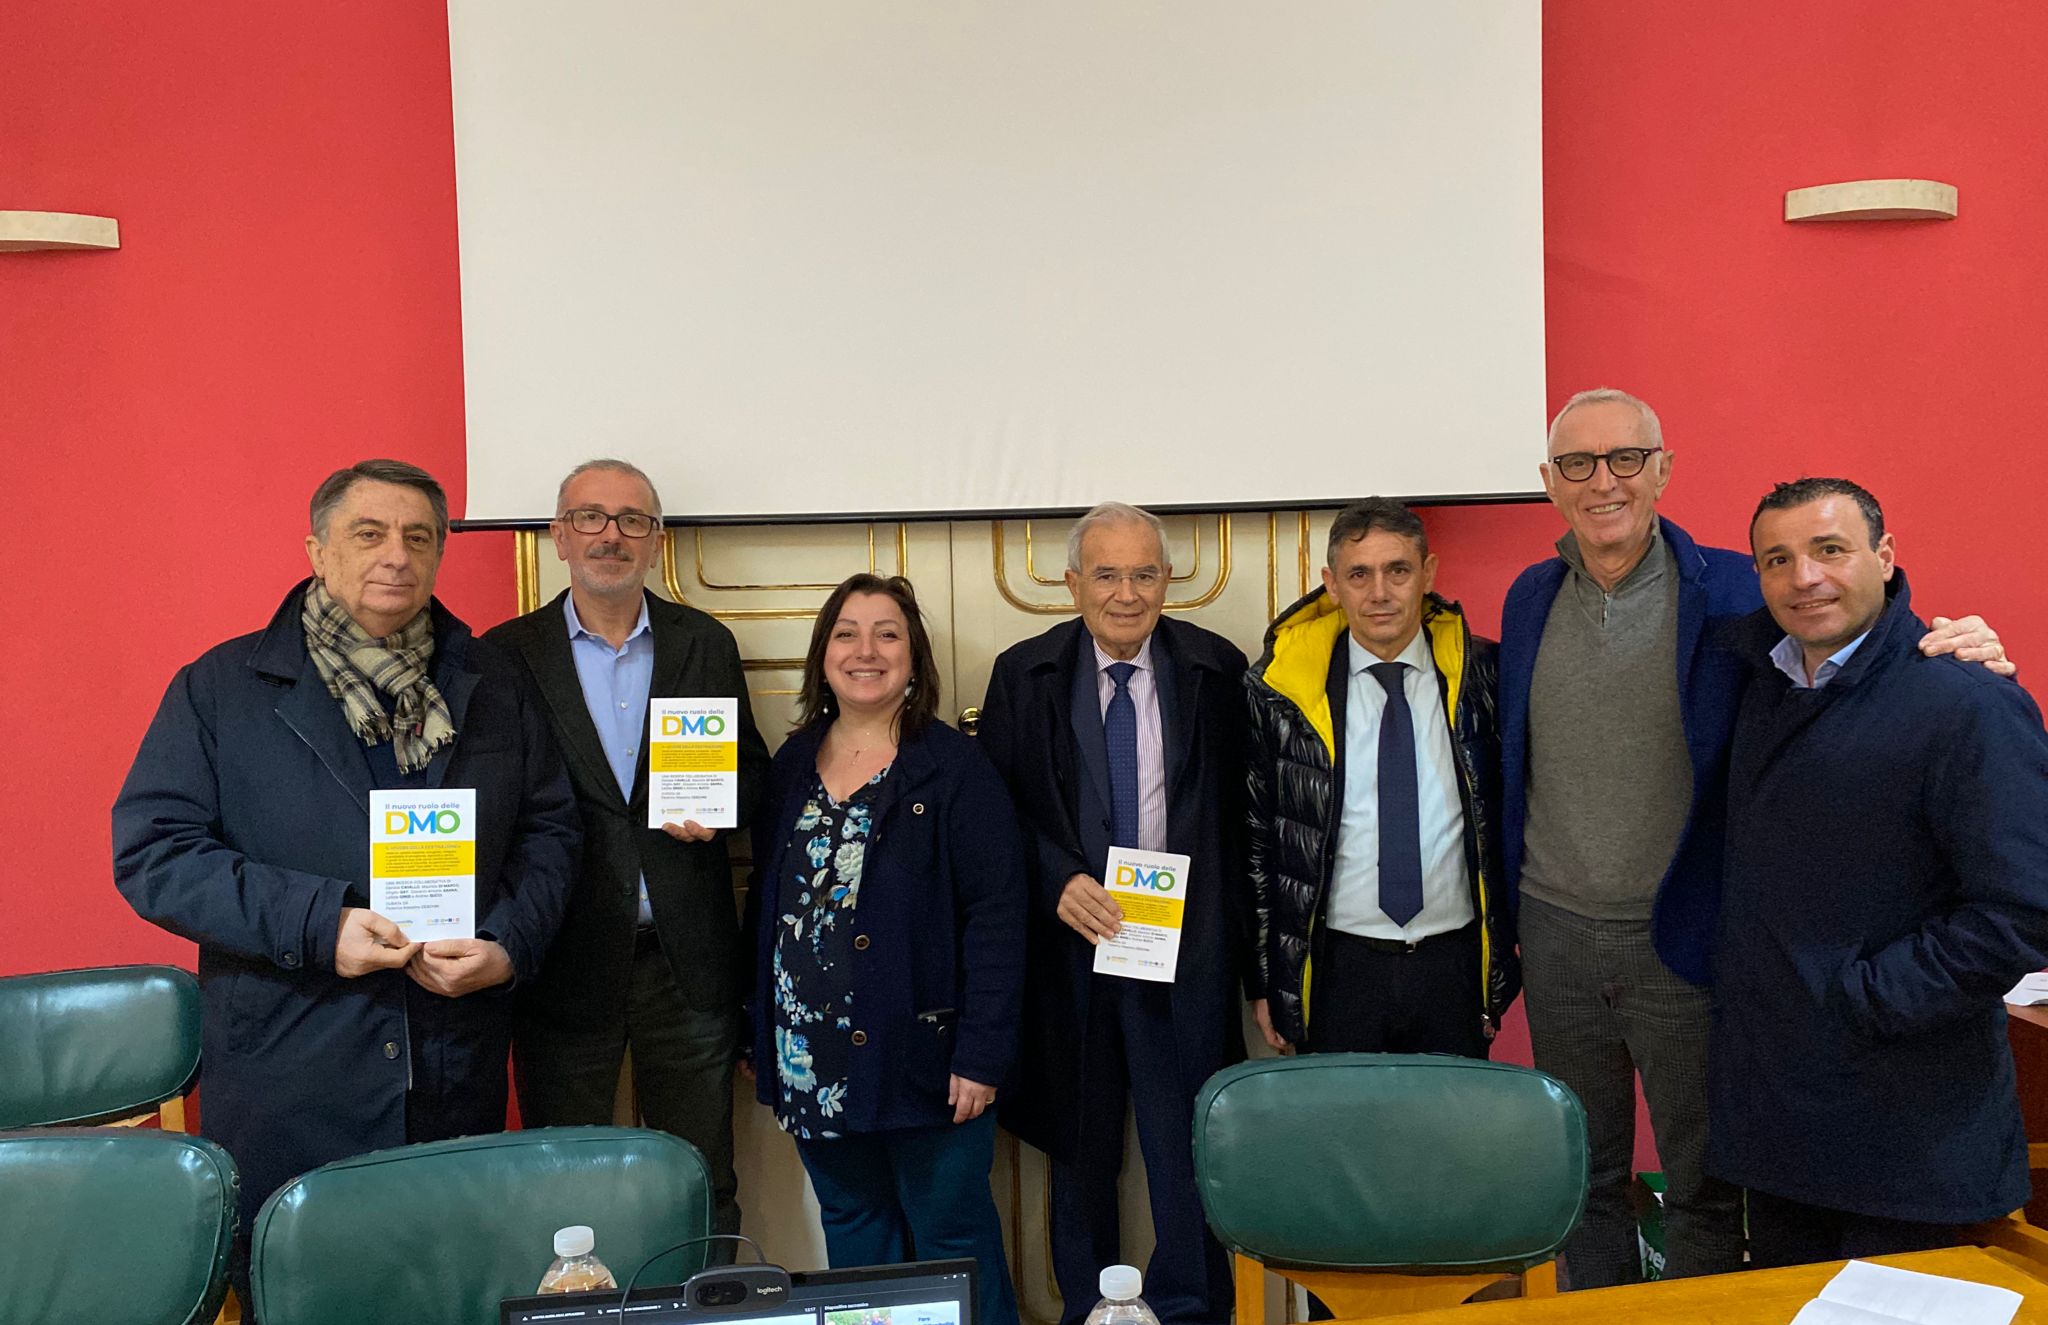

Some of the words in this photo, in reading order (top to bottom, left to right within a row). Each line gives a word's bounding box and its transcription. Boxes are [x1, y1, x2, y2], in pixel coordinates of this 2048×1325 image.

[661, 715, 725, 736] DMO
[384, 809, 461, 835] DMO
[1115, 865, 1176, 892] DMO
[757, 1285, 783, 1296] logitech
